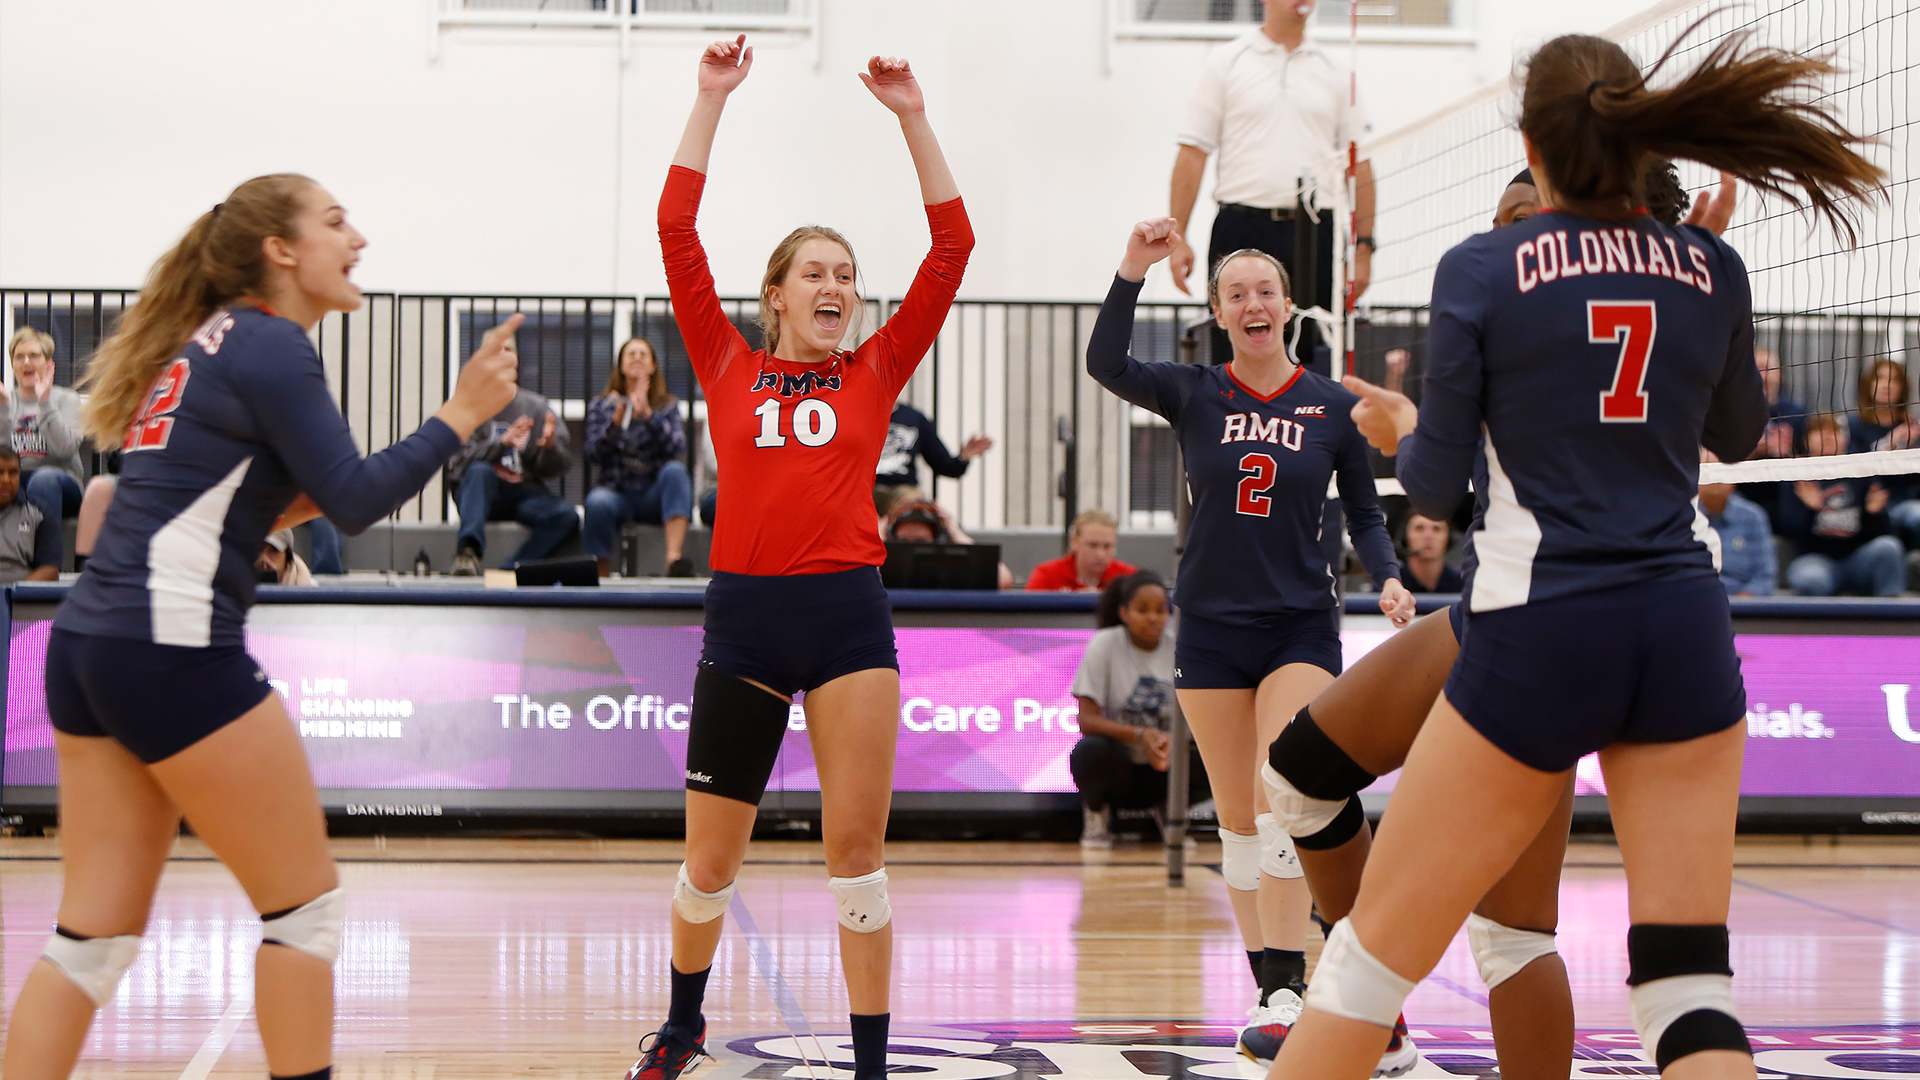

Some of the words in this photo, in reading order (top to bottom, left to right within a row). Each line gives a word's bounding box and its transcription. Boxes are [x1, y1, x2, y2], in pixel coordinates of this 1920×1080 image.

[1515, 228, 1713, 295] COLONIALS
[1586, 300, 1657, 423] 7
[750, 369, 842, 398] RMU
[754, 397, 838, 449] 10
[1293, 405, 1326, 416] NEC
[1220, 411, 1305, 452] RMU
[1236, 452, 1278, 518] 2
[301, 677, 348, 697] LIFE
[300, 698, 414, 718] CHANGING
[492, 694, 572, 730] The
[585, 694, 694, 730] Offic
[901, 697, 1001, 732] Care
[300, 720, 403, 738] MEDICINE
[346, 803, 443, 817] DAKTRONICS
